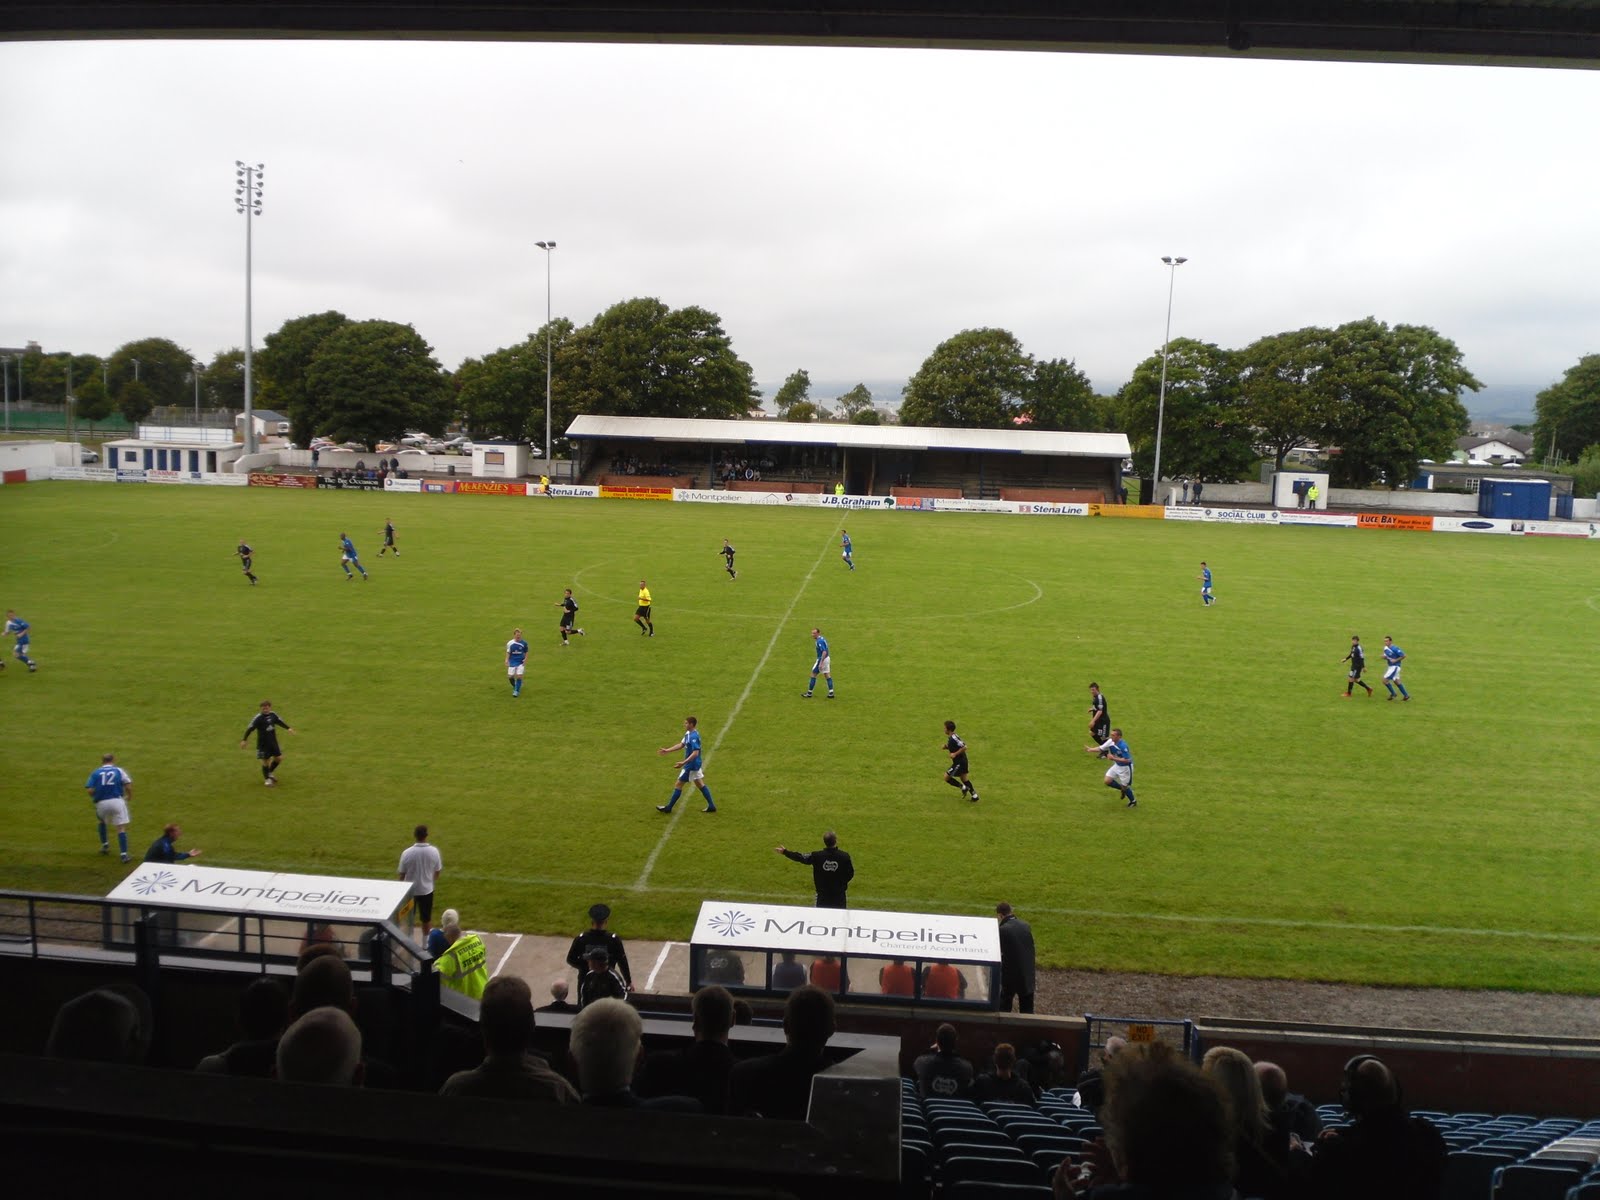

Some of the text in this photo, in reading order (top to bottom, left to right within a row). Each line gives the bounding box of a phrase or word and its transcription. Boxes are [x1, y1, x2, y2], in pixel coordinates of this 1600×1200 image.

[548, 487, 593, 496] Stena Line
[691, 493, 742, 501] Montpelier
[1033, 505, 1060, 513] Stena
[1061, 506, 1082, 514] Line
[1360, 515, 1378, 523] LUCE
[1381, 515, 1397, 523] BAY
[99, 771, 115, 786] 12
[180, 879, 380, 906] Montpelier
[764, 918, 977, 944] Montpelier
[880, 941, 989, 954] Chartered Accountants
[1136, 1025, 1147, 1033] NO
[1131, 1033, 1150, 1041] EXIT
